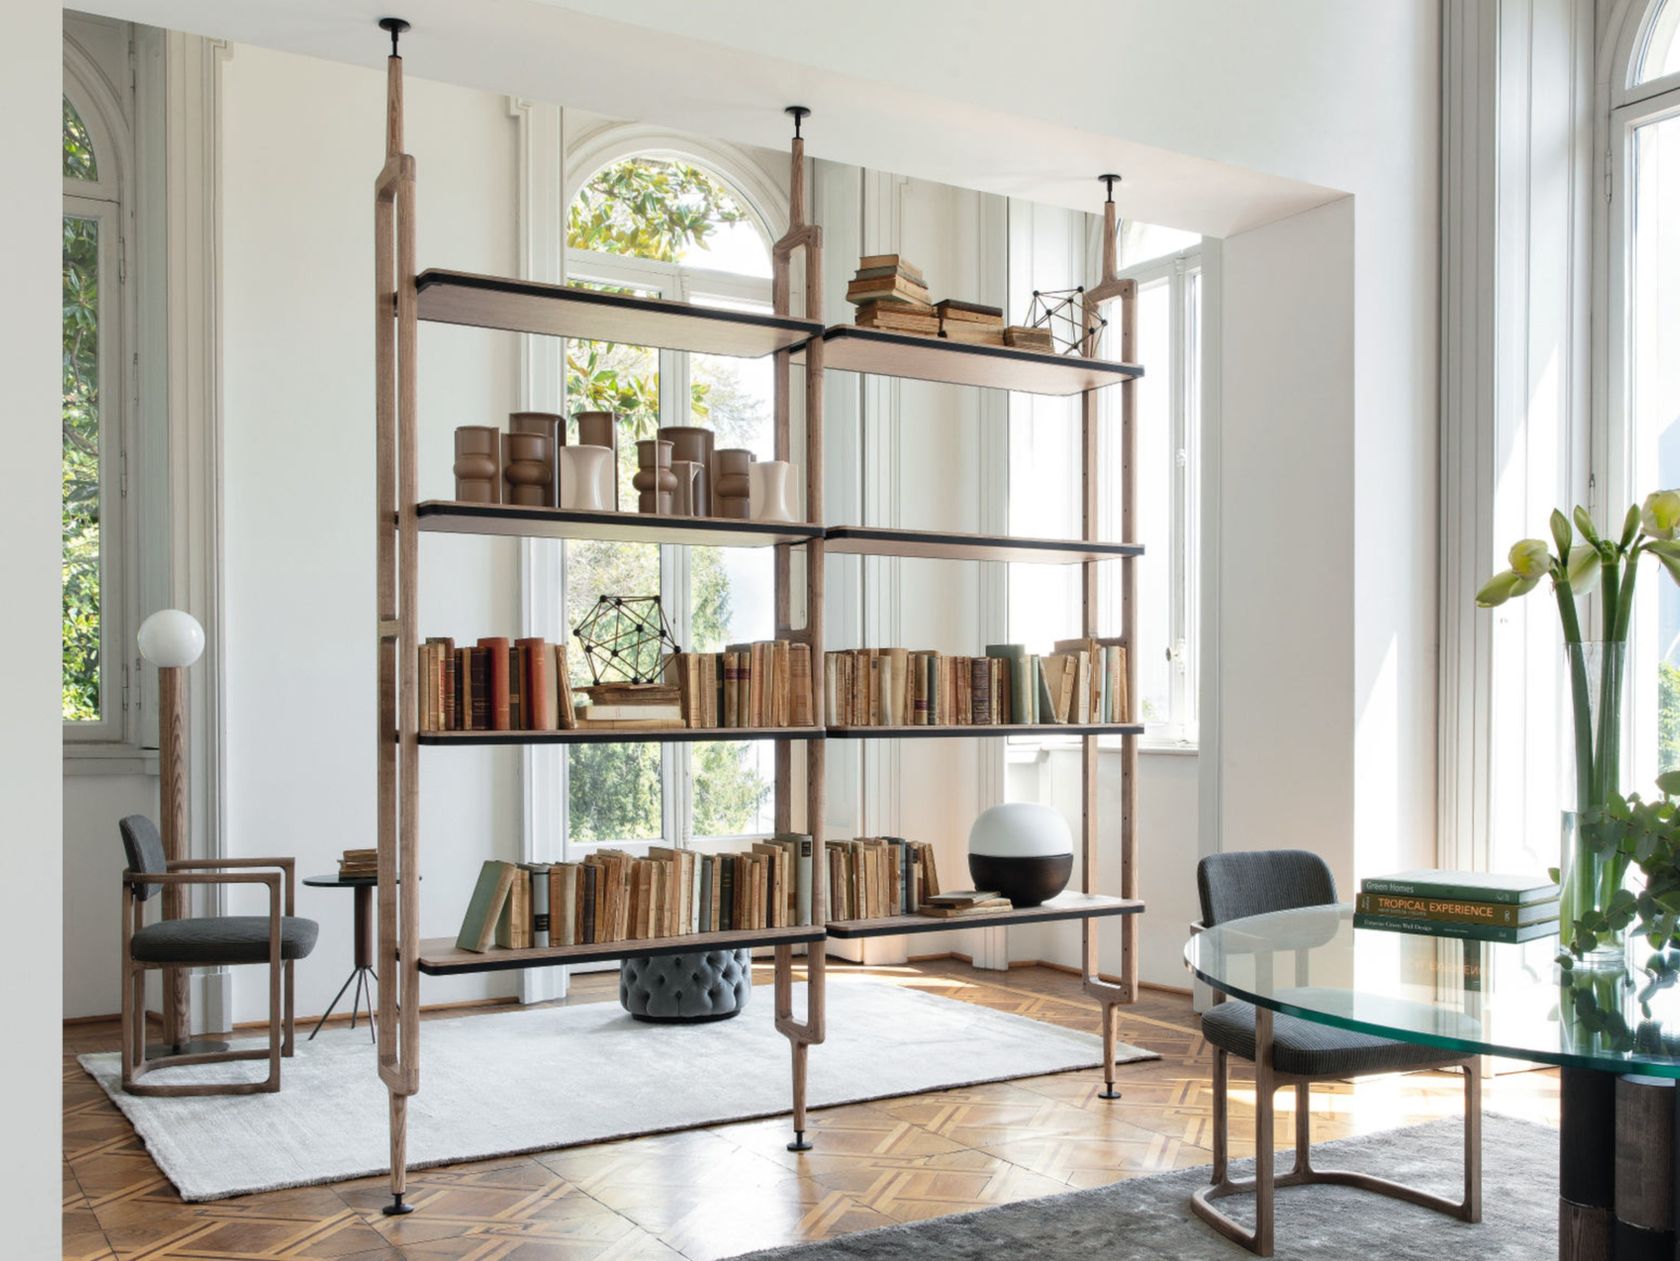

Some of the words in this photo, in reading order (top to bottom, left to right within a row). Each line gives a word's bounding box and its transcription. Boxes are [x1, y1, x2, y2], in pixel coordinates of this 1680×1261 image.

[1366, 882, 1388, 891] Green
[1389, 883, 1414, 893] Homes
[1378, 898, 1426, 911] TROPICAL
[1429, 903, 1494, 917] EXPERIENCE
